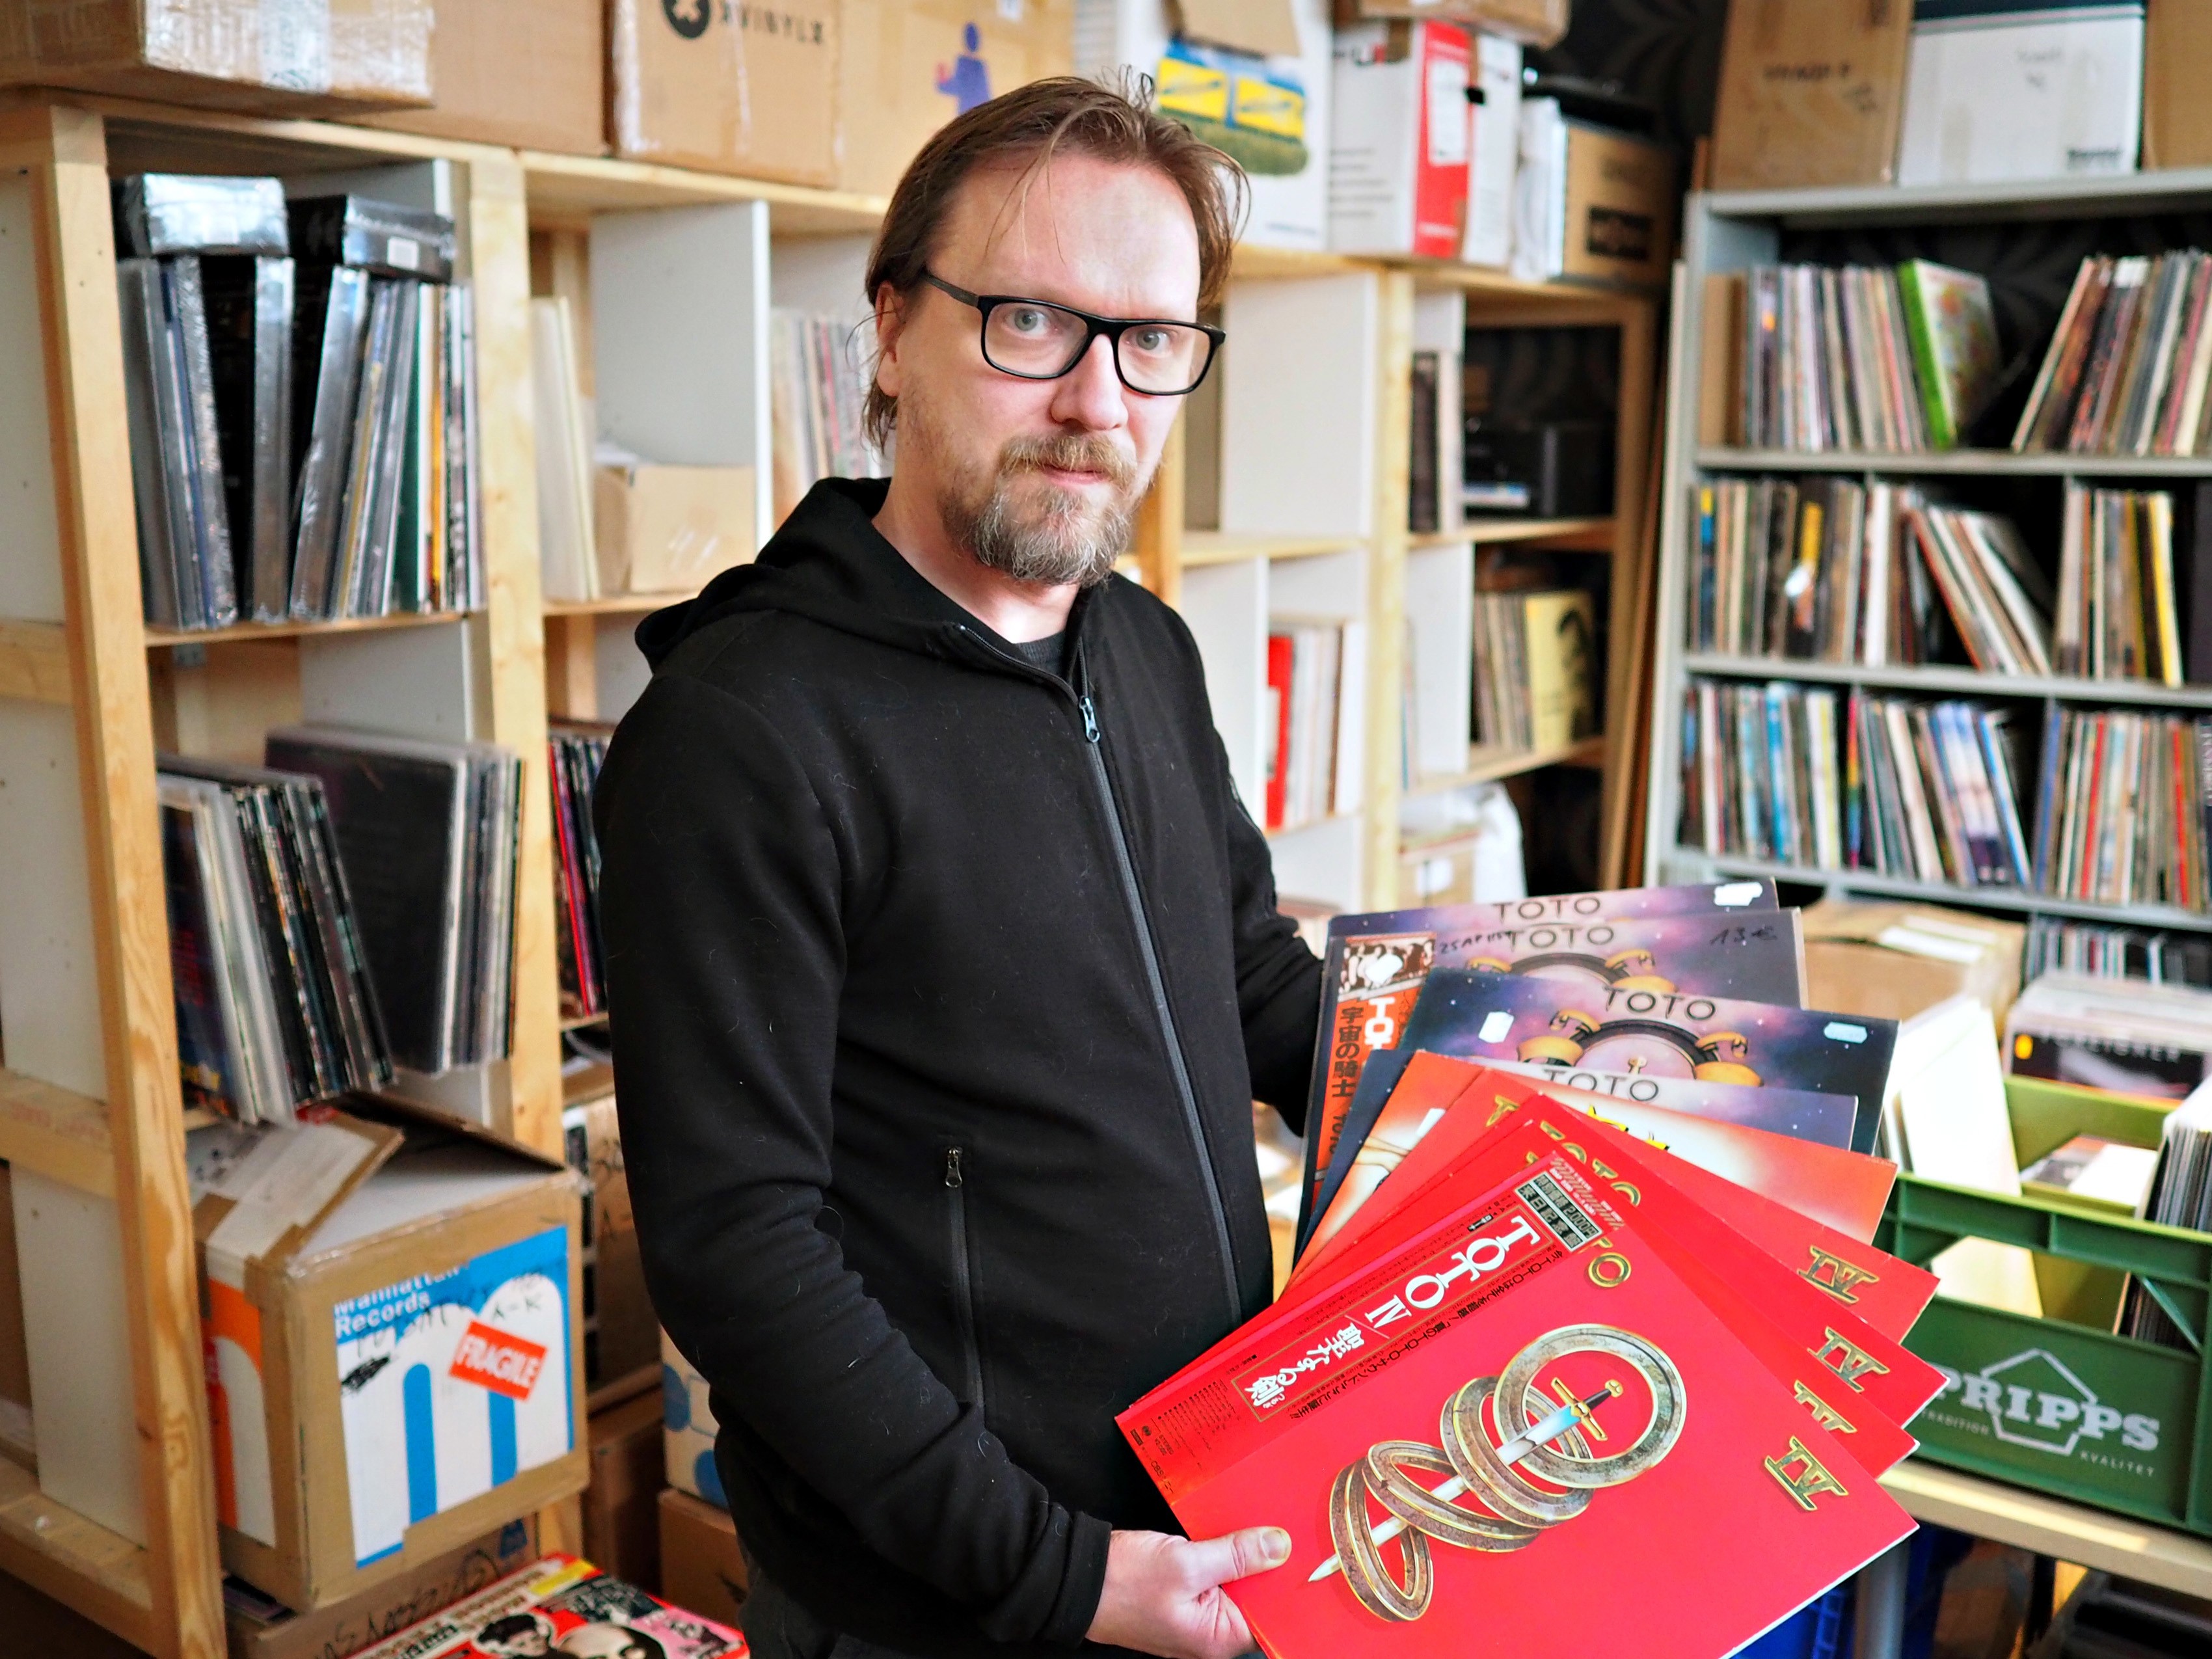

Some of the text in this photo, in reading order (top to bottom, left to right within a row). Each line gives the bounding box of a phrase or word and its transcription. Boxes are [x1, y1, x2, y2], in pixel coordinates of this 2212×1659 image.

[1492, 897, 1600, 923] TOTO
[1505, 926, 1614, 951] TOTO
[1364, 997, 1396, 1050] TOT
[1603, 986, 1717, 1022] TOTO
[1332, 1006, 1364, 1098] 宇宙の騎士
[1543, 1068, 1659, 1101] TOTO
[1405, 1216, 1539, 1308] TOTO
[1798, 1245, 1880, 1304] IV
[336, 1291, 430, 1338] Records
[1365, 1295, 1411, 1327] IV
[455, 1337, 539, 1386] FRAGILE
[1807, 1326, 1890, 1393] IV
[1764, 1435, 1849, 1512] IV
